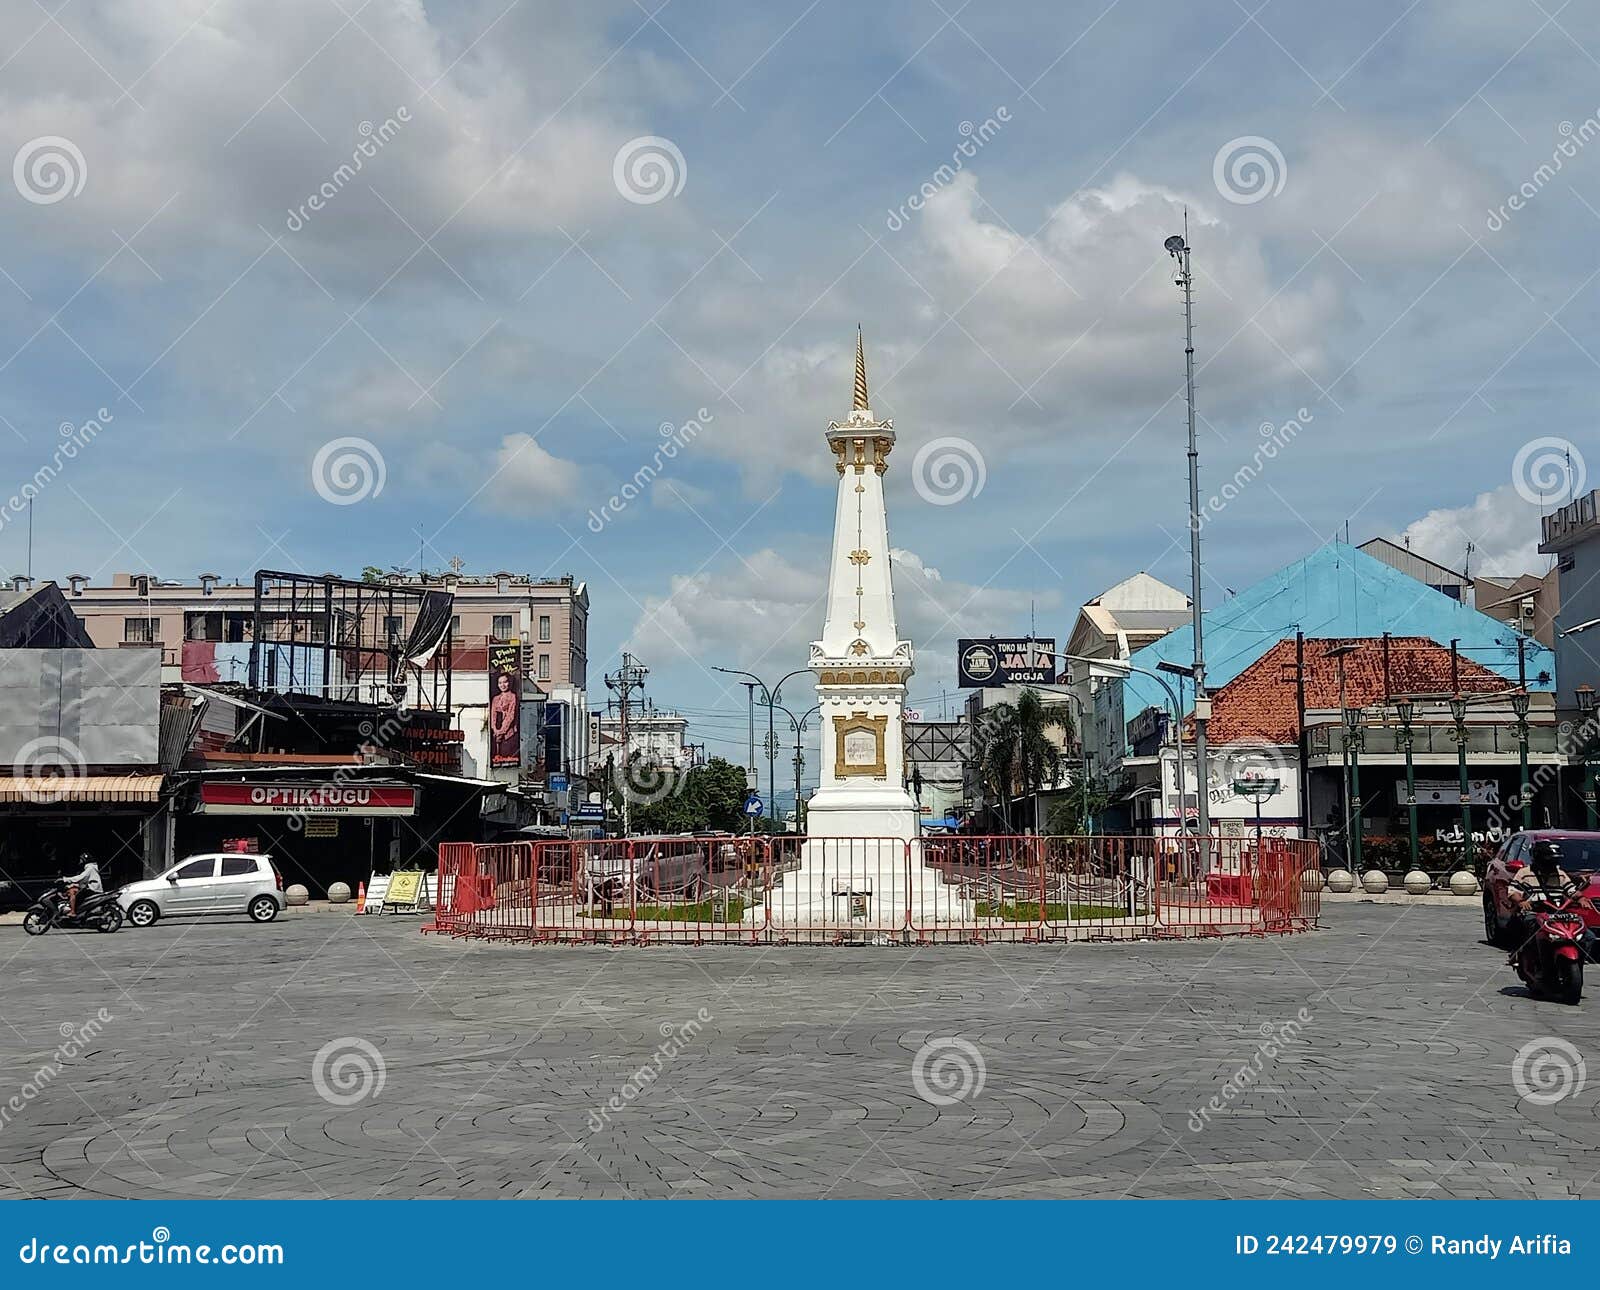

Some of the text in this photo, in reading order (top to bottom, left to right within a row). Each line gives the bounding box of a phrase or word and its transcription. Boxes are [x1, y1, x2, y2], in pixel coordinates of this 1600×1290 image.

[998, 644, 1016, 652] TOKO
[969, 659, 989, 668] JAWA
[1007, 672, 1045, 681] JOGJA
[251, 788, 371, 805] OPTIK TUGU
